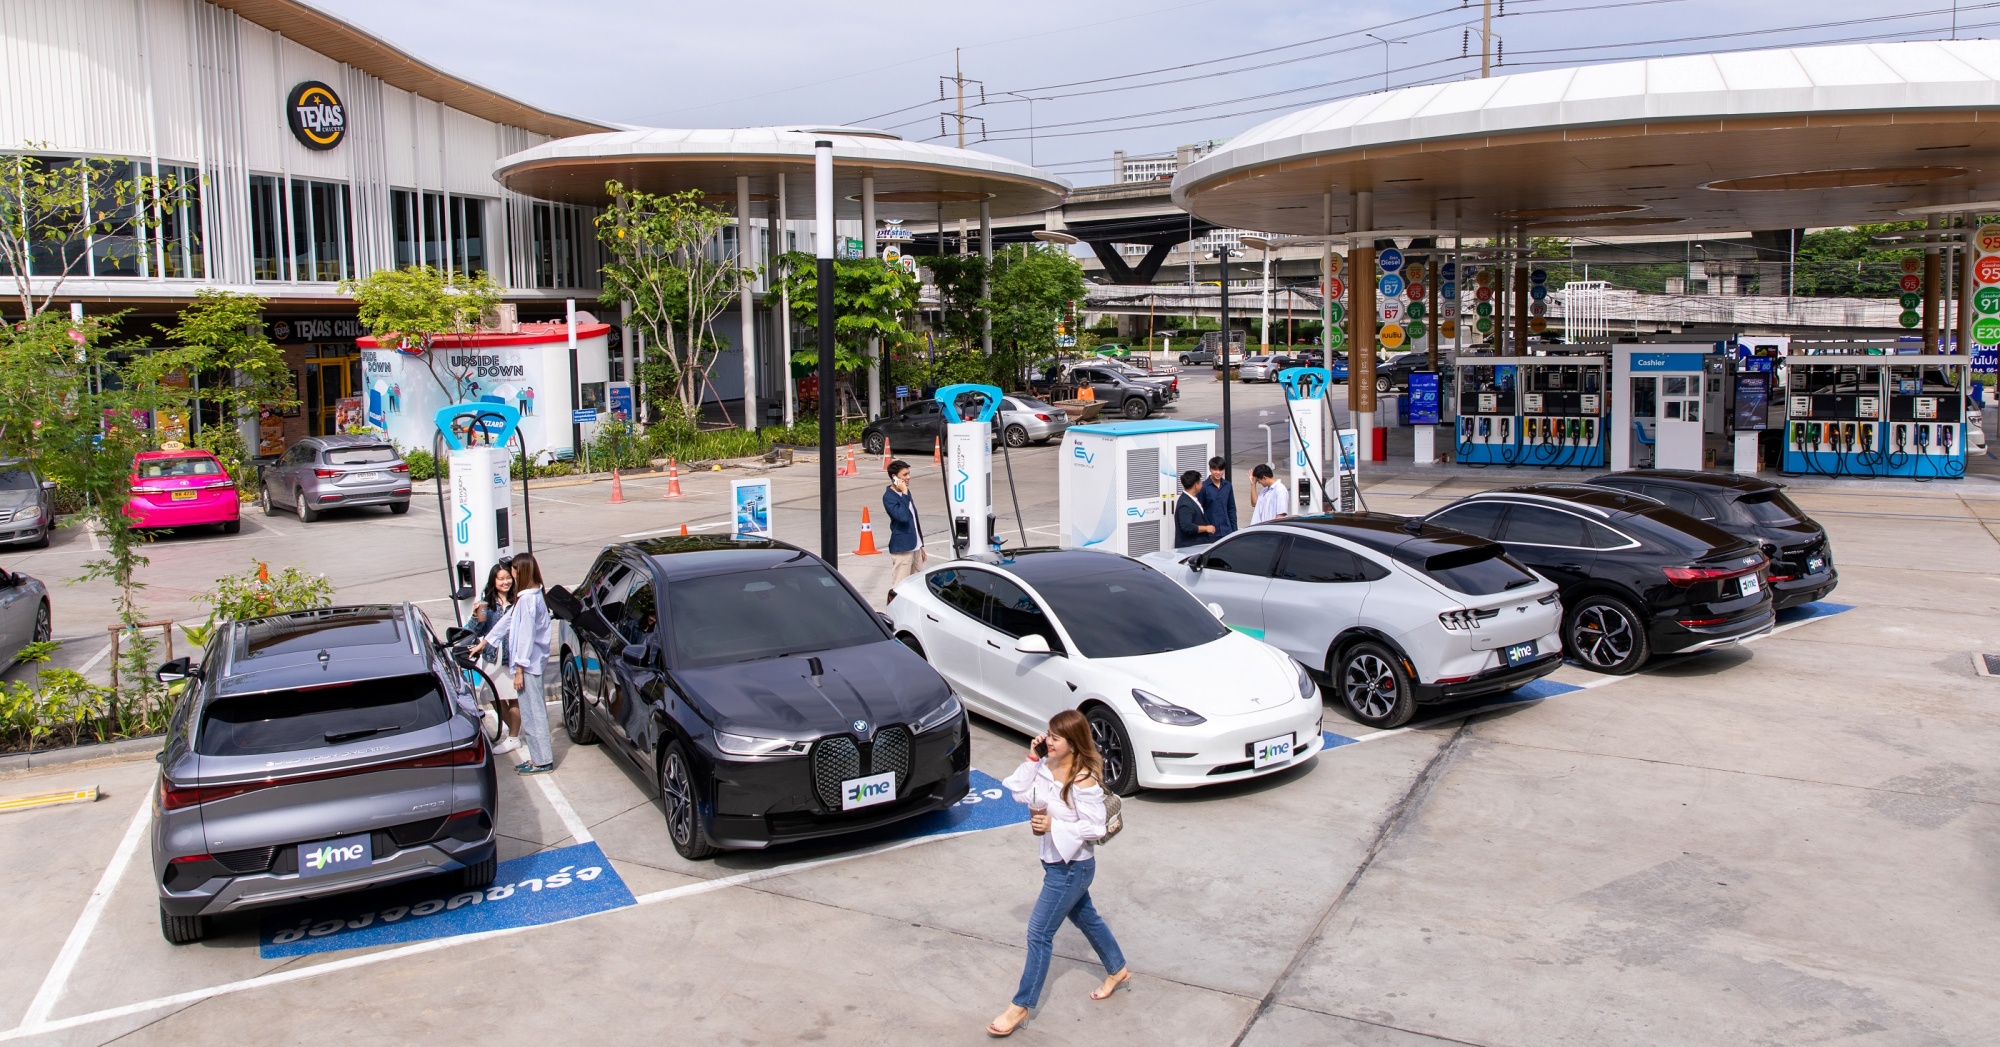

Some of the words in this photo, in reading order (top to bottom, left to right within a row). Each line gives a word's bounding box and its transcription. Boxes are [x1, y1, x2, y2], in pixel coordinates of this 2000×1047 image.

[297, 104, 343, 132] TEXAS
[877, 229, 890, 237] ptt
[1983, 237, 2000, 249] 95
[1331, 263, 1338, 272] 5
[1410, 271, 1421, 279] 95
[1981, 267, 2000, 280] 95
[1384, 284, 1398, 294] B7
[1905, 281, 1916, 289] 95
[1331, 287, 1338, 297] 5
[1410, 290, 1421, 298] 95
[1981, 298, 1999, 310] 91
[1384, 310, 1398, 319] B7
[1410, 309, 1420, 317] 91
[294, 319, 331, 341] TEXAS
[334, 320, 371, 337] CHICK
[1977, 328, 2000, 339] E20
[1331, 334, 1340, 343] 20
[451, 355, 500, 367] UPSIDE
[368, 361, 392, 373] DOWN
[477, 365, 524, 378] DOWN
[1074, 447, 1094, 464] EV
[954, 469, 969, 502] EV
[1127, 507, 1146, 517] EV
[457, 504, 472, 544] EV
[272, 865, 603, 944] ช่องจอดชาร์จ
